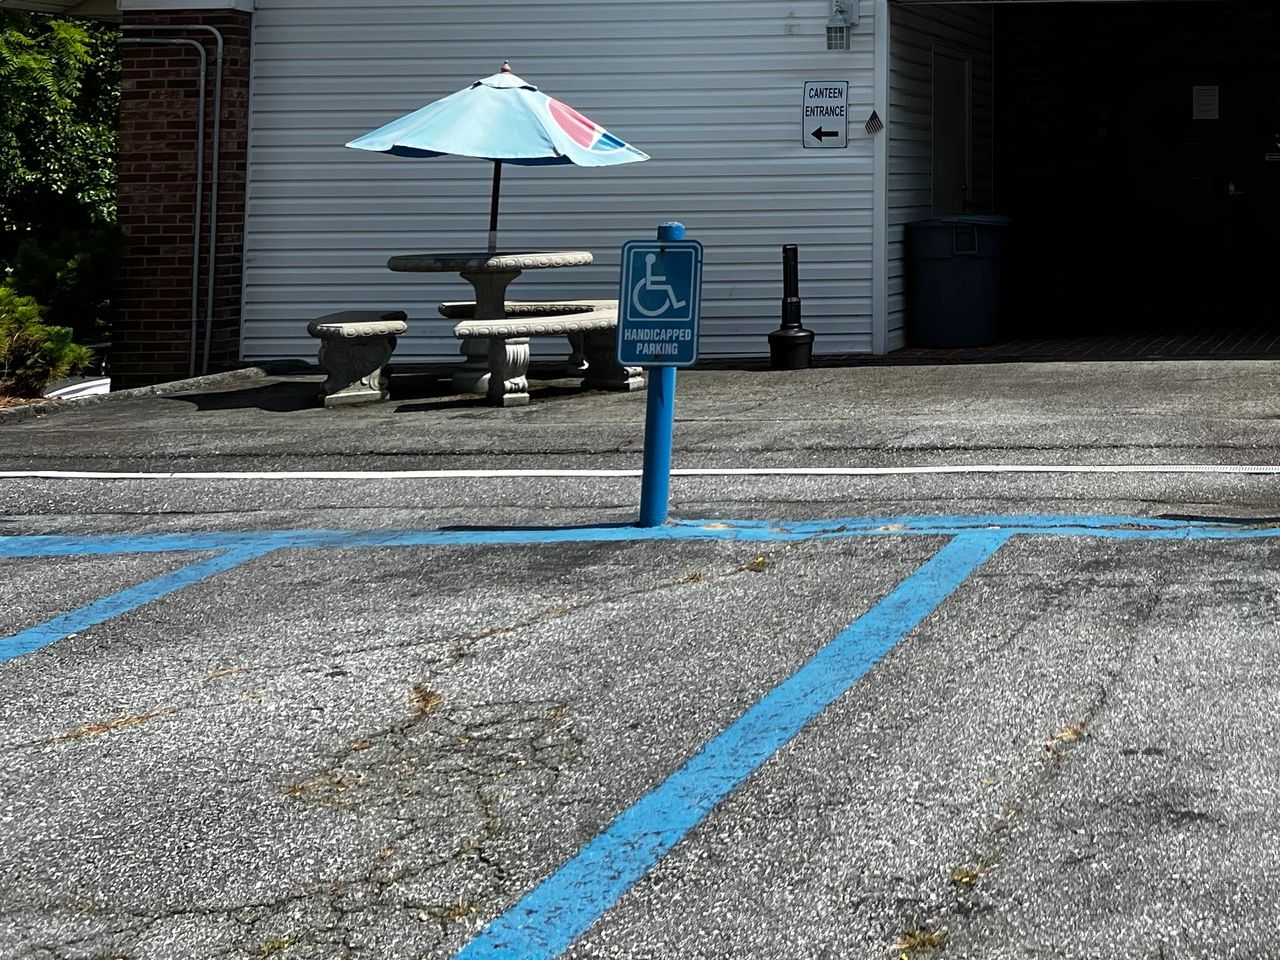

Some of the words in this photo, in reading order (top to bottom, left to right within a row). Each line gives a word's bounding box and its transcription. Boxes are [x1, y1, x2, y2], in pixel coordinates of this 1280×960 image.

[809, 88, 843, 99] CANTEEN
[805, 106, 844, 117] ENTRANCE
[624, 328, 692, 341] HANDICAPPED
[636, 343, 678, 355] PARKING
